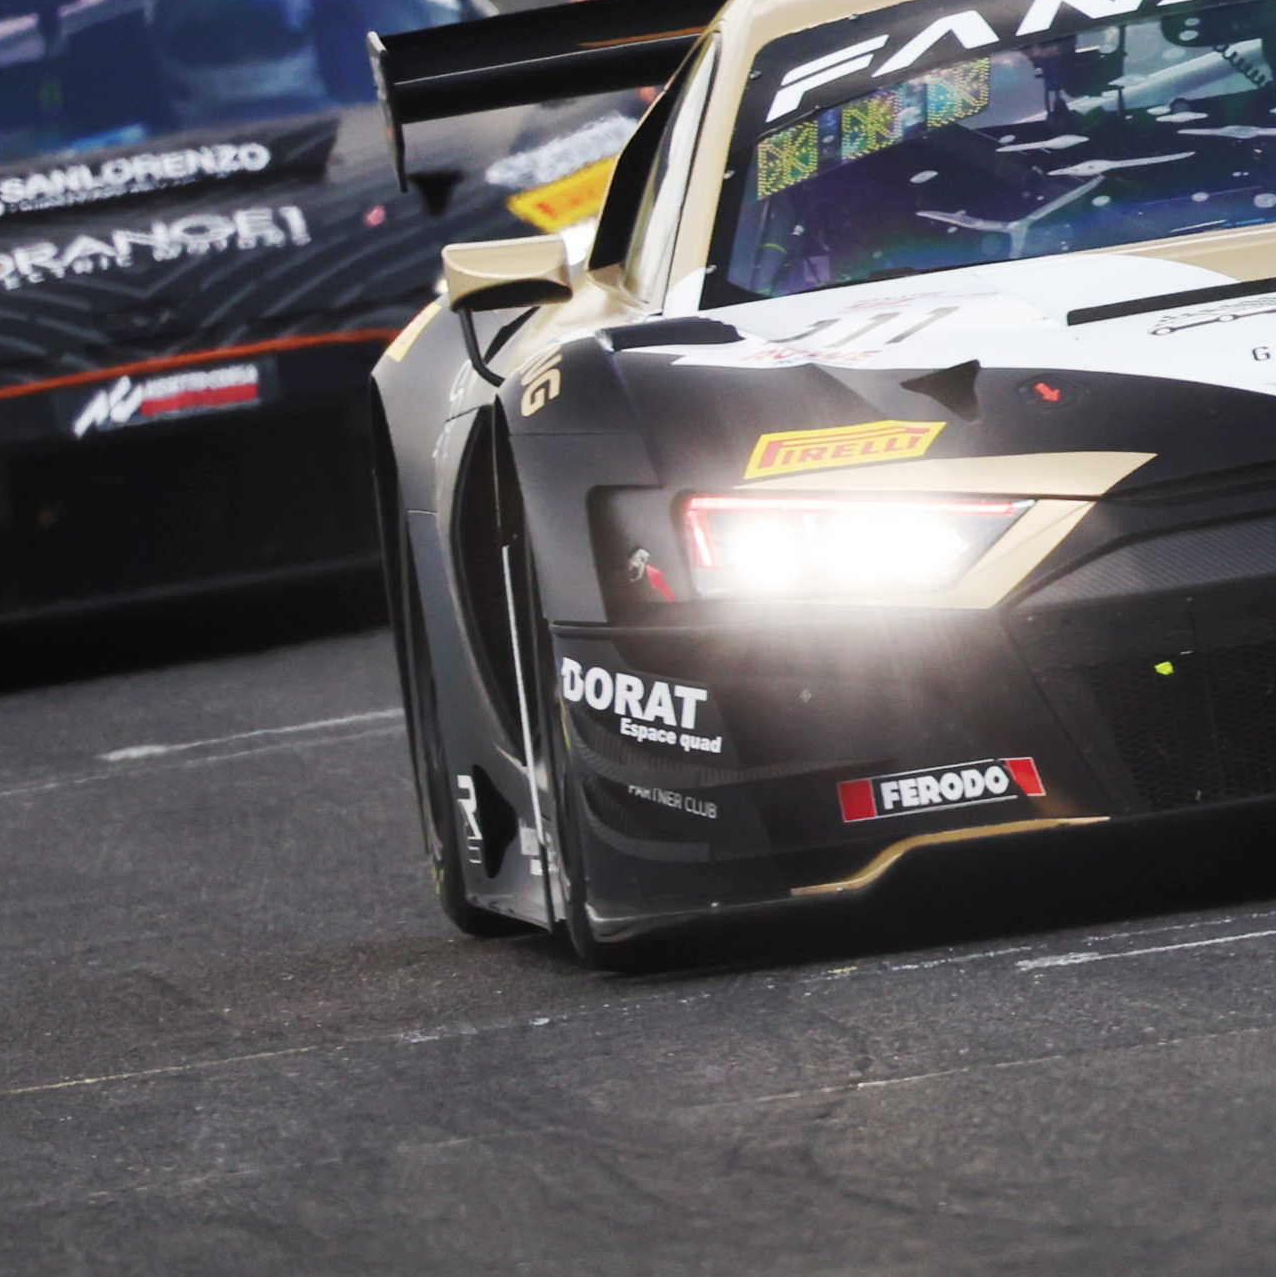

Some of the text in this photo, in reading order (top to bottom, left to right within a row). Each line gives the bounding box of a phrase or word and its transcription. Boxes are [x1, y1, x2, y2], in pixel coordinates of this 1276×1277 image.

[758, 424, 931, 471] PIRELLI
[560, 656, 708, 730] DORAT
[619, 717, 722, 753] Espace quad
[684, 796, 718, 820] CLUB
[879, 765, 1010, 811] FERODO
